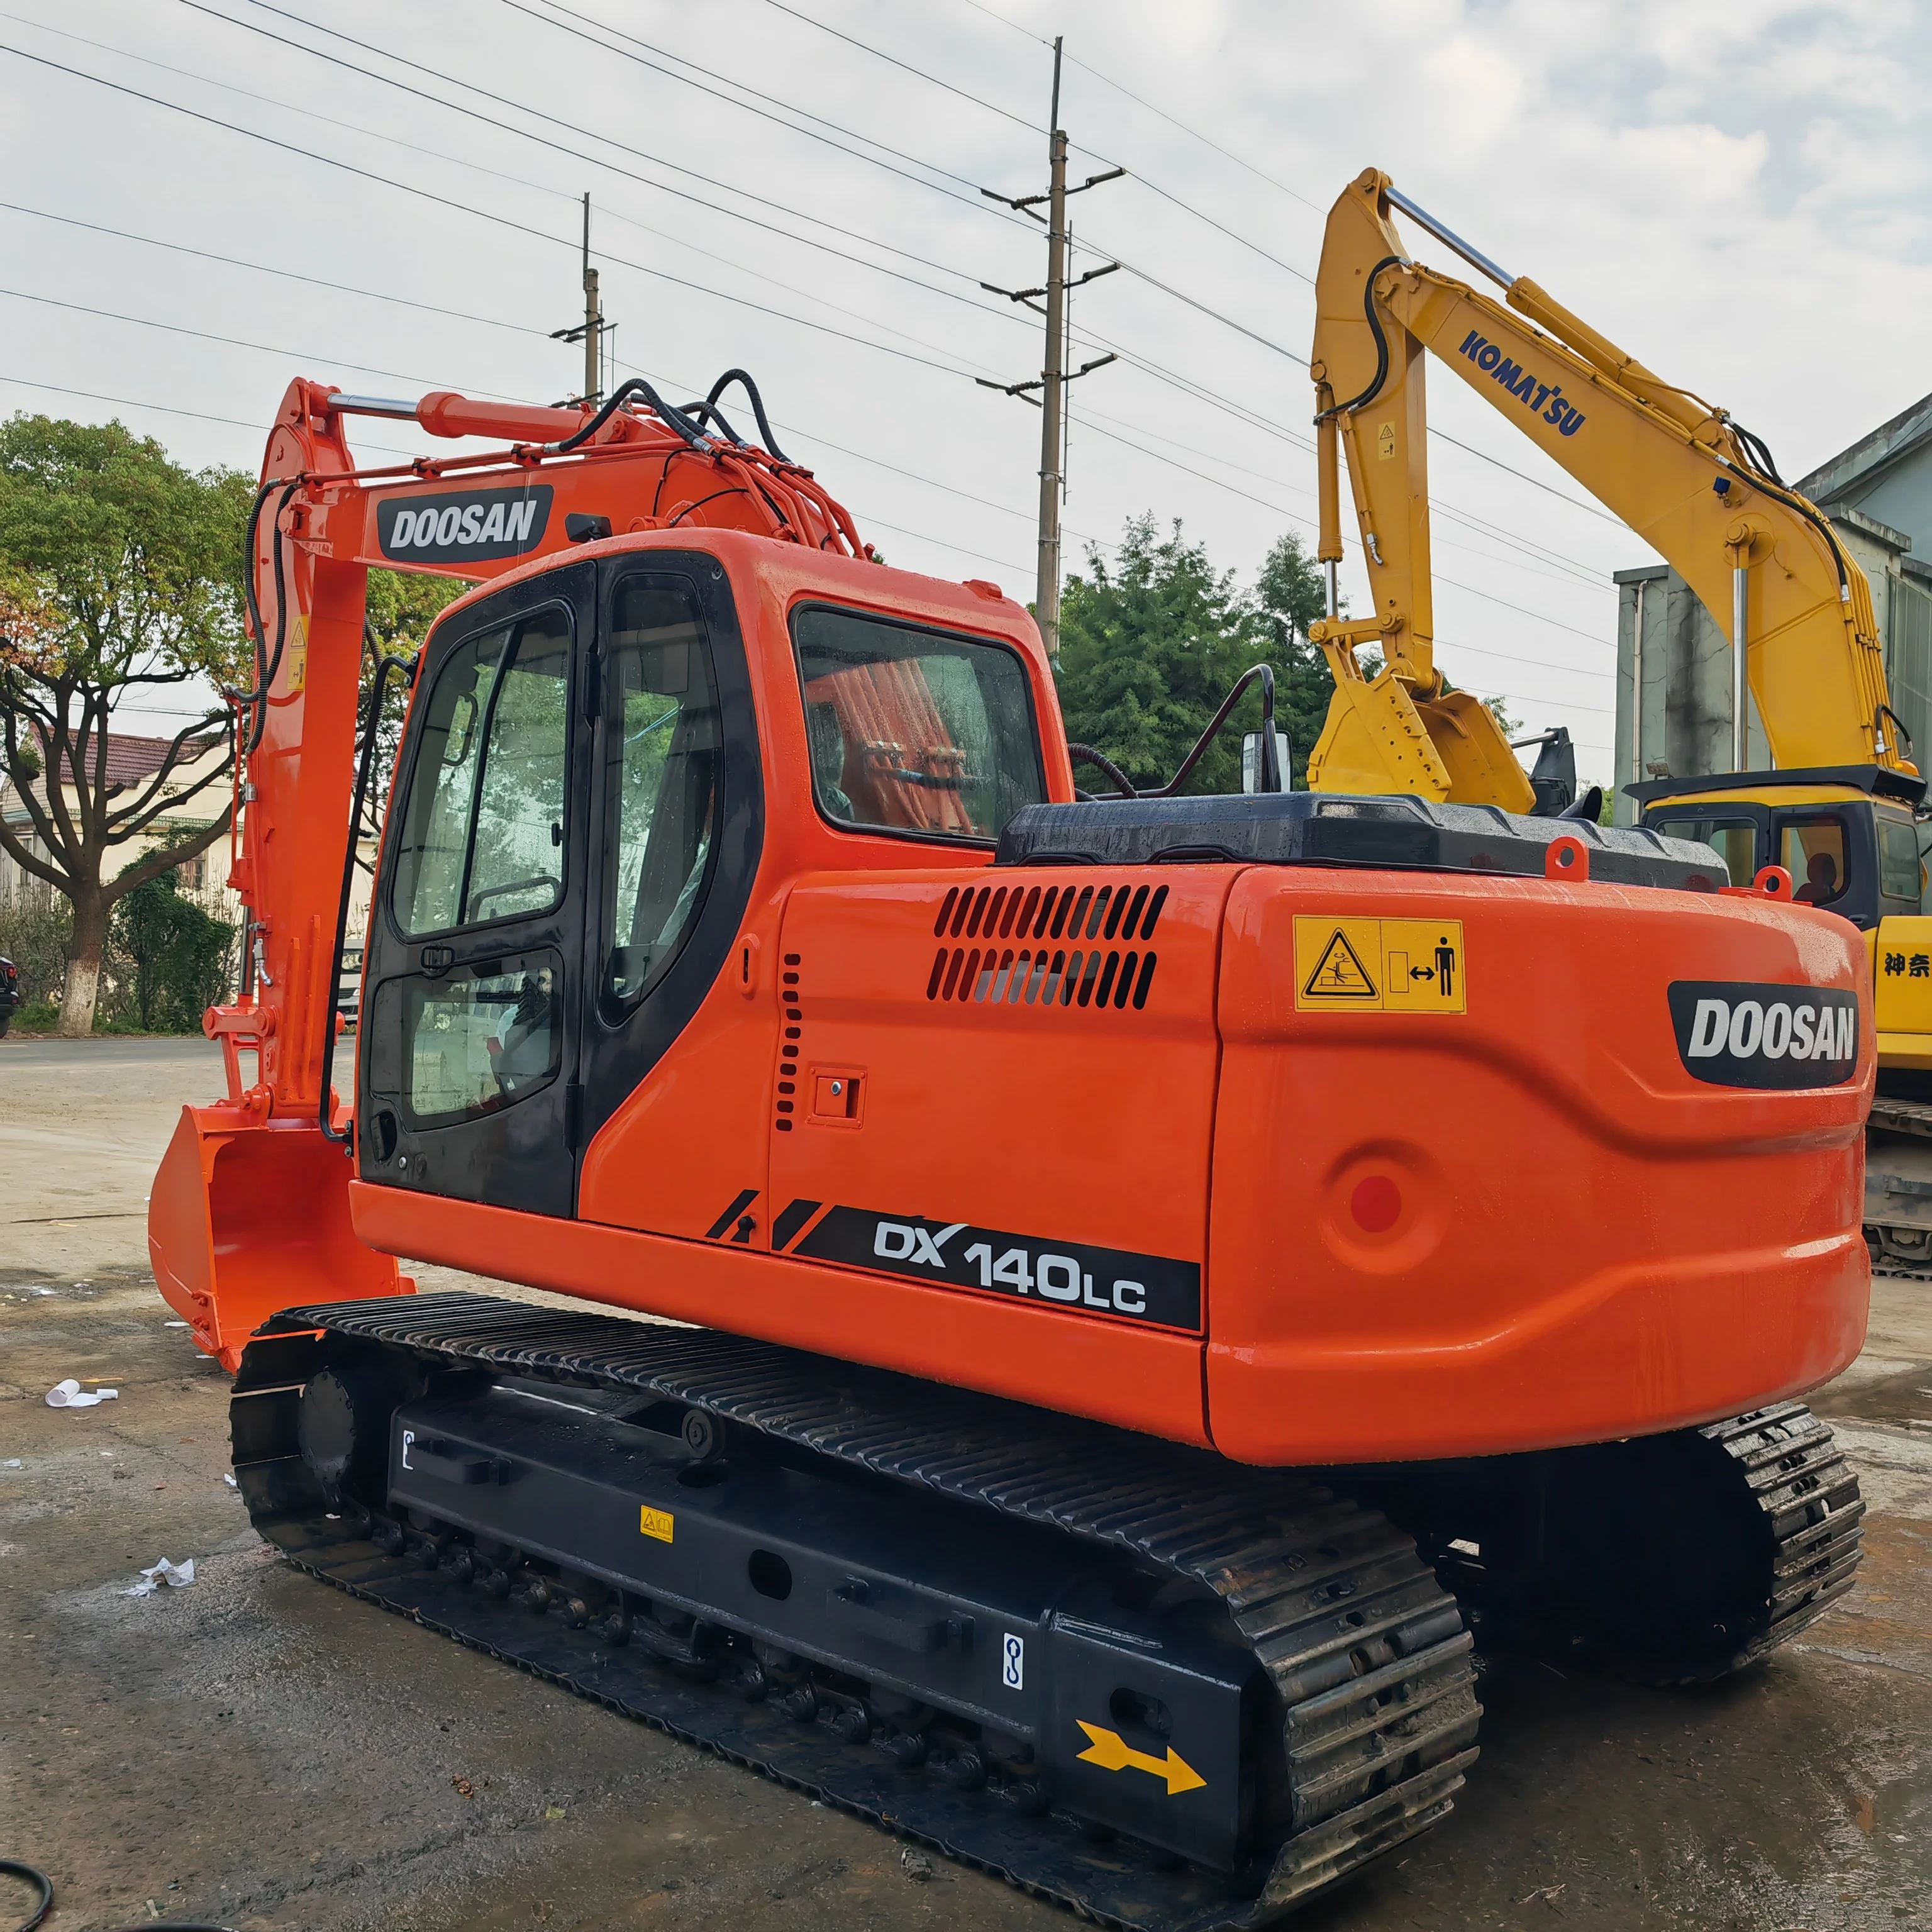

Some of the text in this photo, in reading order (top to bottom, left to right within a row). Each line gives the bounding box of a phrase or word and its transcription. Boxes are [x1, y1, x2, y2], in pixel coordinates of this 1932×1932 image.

[1459, 330, 1585, 436] KOMATSU
[390, 500, 536, 548] DOOSAN
[1688, 999, 1854, 1060] DOOSAN
